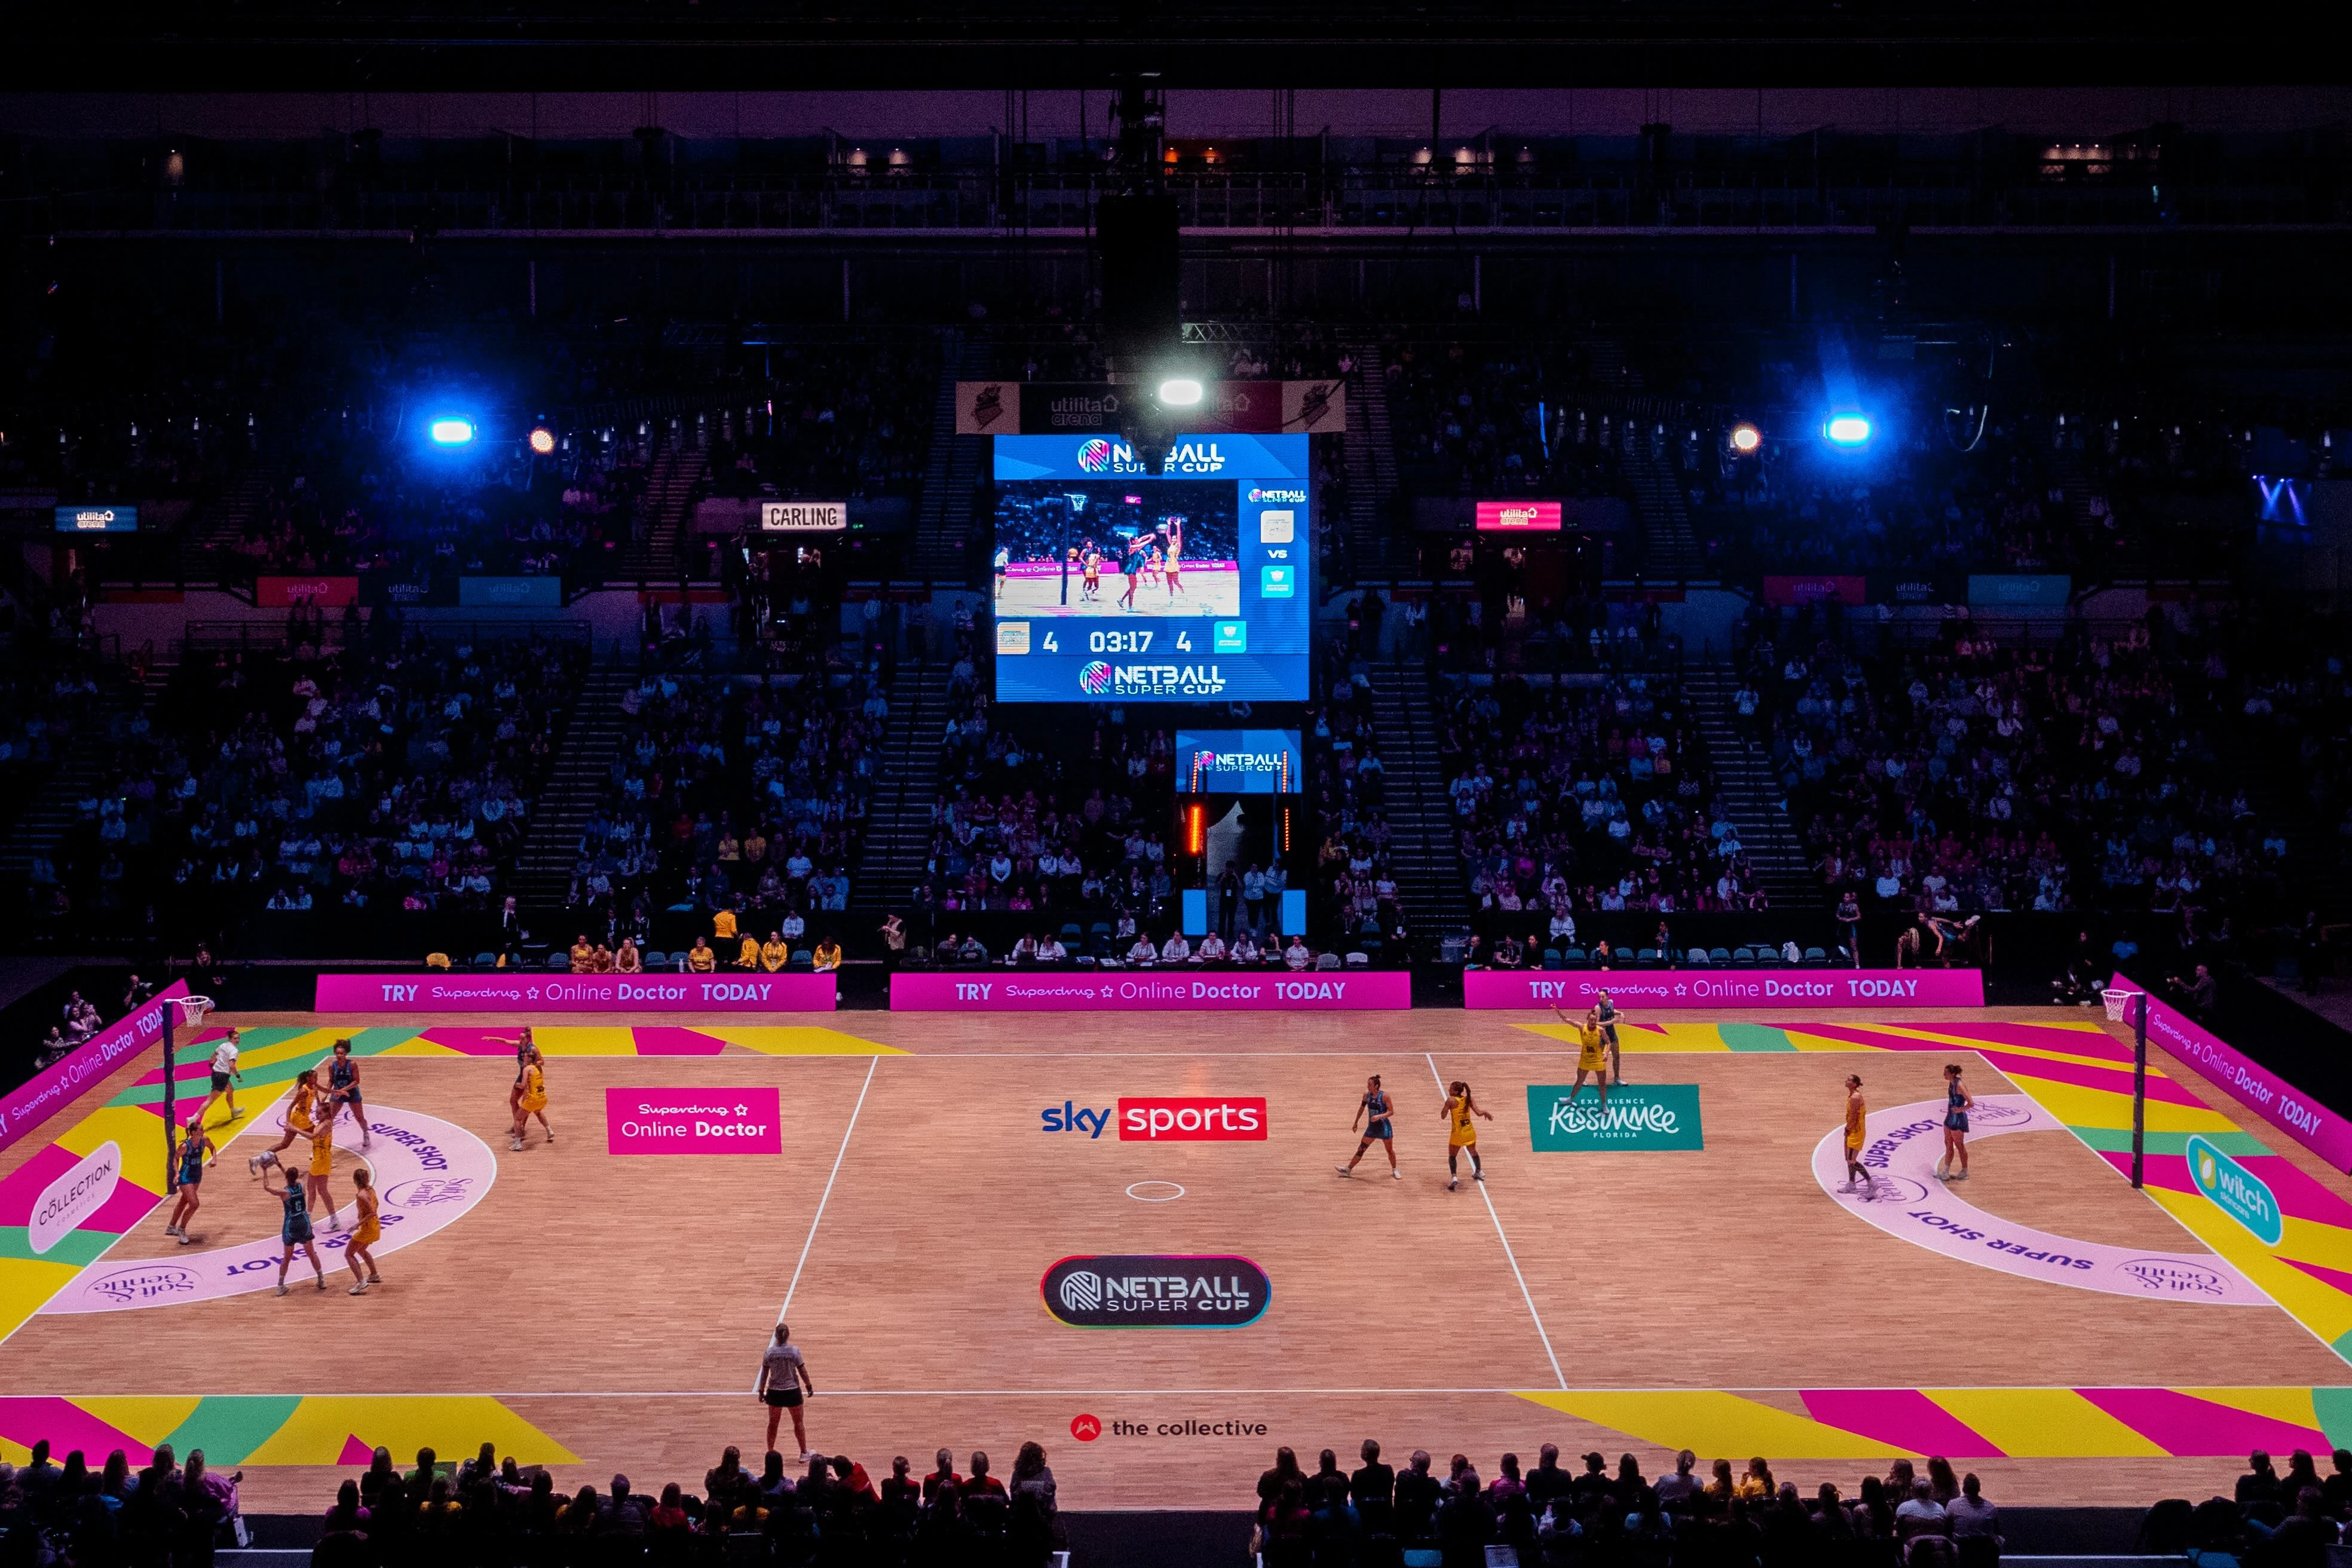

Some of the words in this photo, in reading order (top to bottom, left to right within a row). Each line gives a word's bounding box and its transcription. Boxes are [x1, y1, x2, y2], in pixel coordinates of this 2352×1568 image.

[1051, 397, 1102, 412] utilita
[1052, 414, 1102, 426] arena
[1114, 443, 1225, 463] NBALL
[1182, 463, 1222, 472] CUP
[1262, 490, 1306, 498] NETBALL
[76, 512, 105, 520] utilita
[771, 507, 837, 526] CARLING
[1500, 509, 1528, 518] utilita
[1267, 549, 1288, 558] VS
[388, 583, 419, 593] utilita
[1895, 583, 1927, 592] utilita
[1043, 631, 1058, 653] 4
[1089, 631, 1153, 653] 03:17
[1176, 631, 1192, 653] 4
[1114, 665, 1226, 684] NETBALL
[1115, 685, 1176, 694] SUPER
[1183, 685, 1223, 694] CUP
[1215, 754, 1282, 765] NETBALL
[382, 985, 419, 1002] TRY
[431, 987, 521, 1000] Superdrug
[546, 984, 611, 1000] Online
[618, 984, 687, 1000] Doctor
[701, 984, 772, 1001] TODAY
[956, 984, 993, 1000] TRY
[1006, 985, 1095, 999] Superdrug
[1120, 982, 1186, 999] Online
[1192, 982, 1261, 999] Doctor
[1275, 982, 1346, 1000] TODAY
[1529, 981, 1566, 998] TRY
[1693, 980, 1759, 997] Online
[1765, 980, 1833, 996] Doctor
[1848, 980, 1918, 997] TODAY
[12, 1085, 61, 1120] Superdrug
[69, 1054, 103, 1083] Online
[101, 1031, 135, 1061] Doctor
[136, 1006, 164, 1037] TODA
[2201, 1045, 2235, 1080] Online
[2234, 1067, 2273, 1104] Doctor
[2277, 1095, 2322, 1136] TODAY
[638, 1104, 730, 1116] Superdrug
[621, 1121, 687, 1137] Online
[695, 1121, 767, 1137] Doctor
[1042, 1101, 1111, 1139] sky
[1126, 1104, 1259, 1138] sports
[368, 1123, 426, 1147] SUPER
[412, 1146, 448, 1171] SHOT
[1863, 1139, 1903, 1168] SUPER
[1888, 1119, 1943, 1140] SHOT
[2219, 1168, 2269, 1222] witch
[1907, 1211, 1985, 1240] SHOT
[1986, 1239, 2094, 1269] SUPER
[1106, 1276, 1250, 1298] NETBALL
[1107, 1300, 1187, 1311] SUPER
[1197, 1300, 1250, 1310] CUP
[1112, 1420, 1149, 1436] the
[1157, 1420, 1267, 1436] collective
